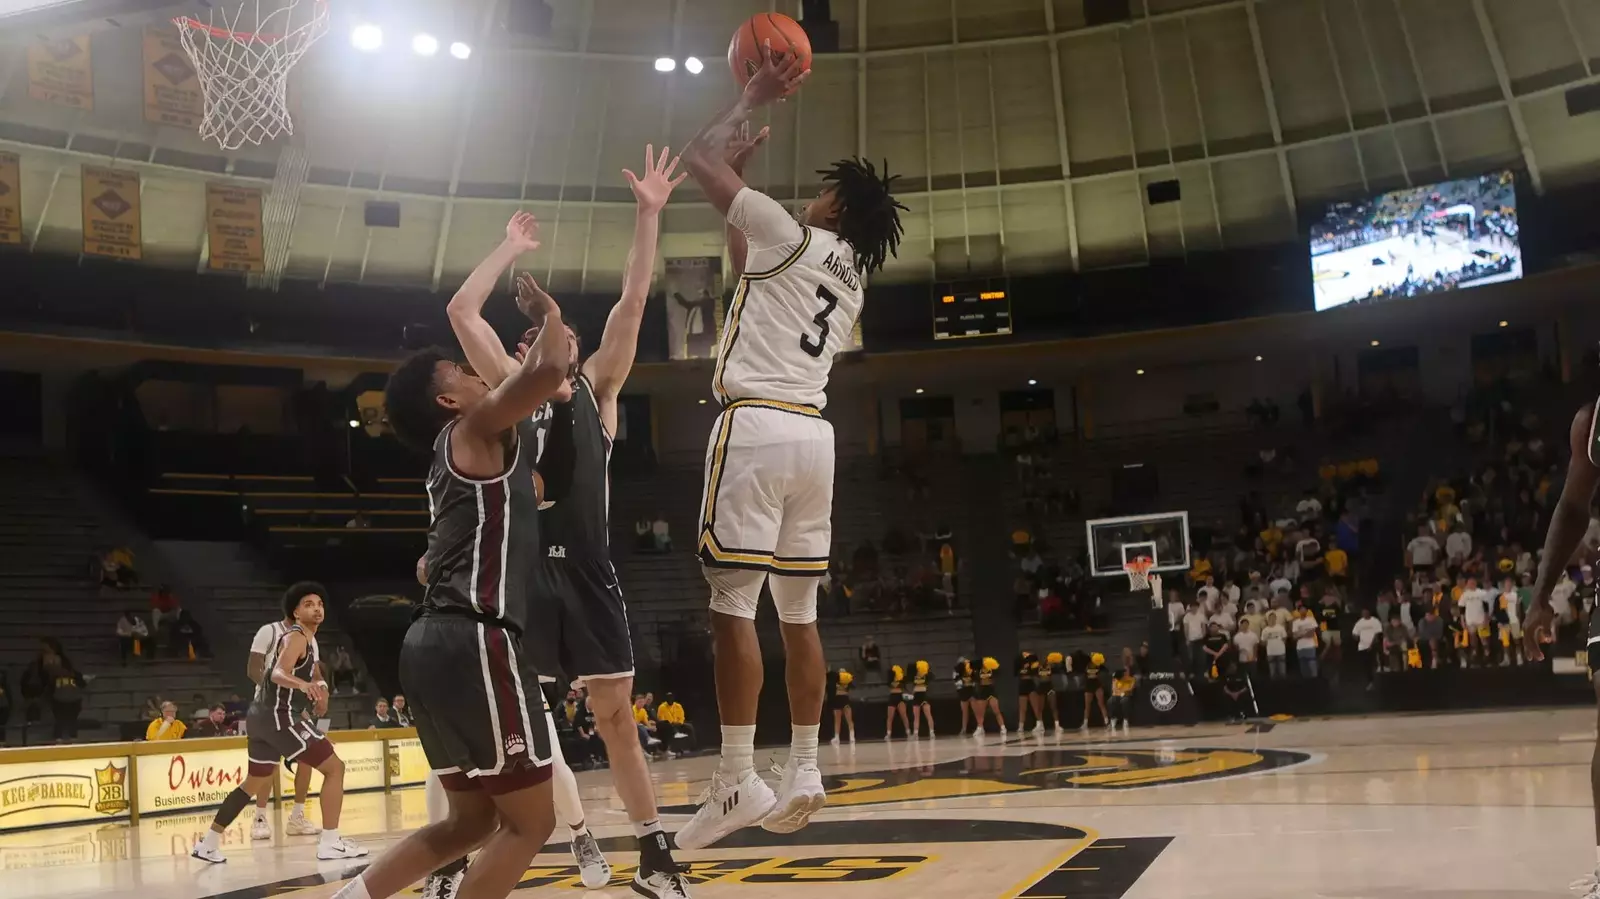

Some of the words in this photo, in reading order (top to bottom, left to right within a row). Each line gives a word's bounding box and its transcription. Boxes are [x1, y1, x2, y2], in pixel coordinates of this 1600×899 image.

[823, 250, 860, 292] ARNOLD
[800, 283, 839, 358] 3
[168, 755, 243, 790] Owens
[1, 786, 26, 808] KEG
[41, 782, 86, 800] BARREL
[154, 793, 196, 808] Business
[198, 788, 231, 804] Machin
